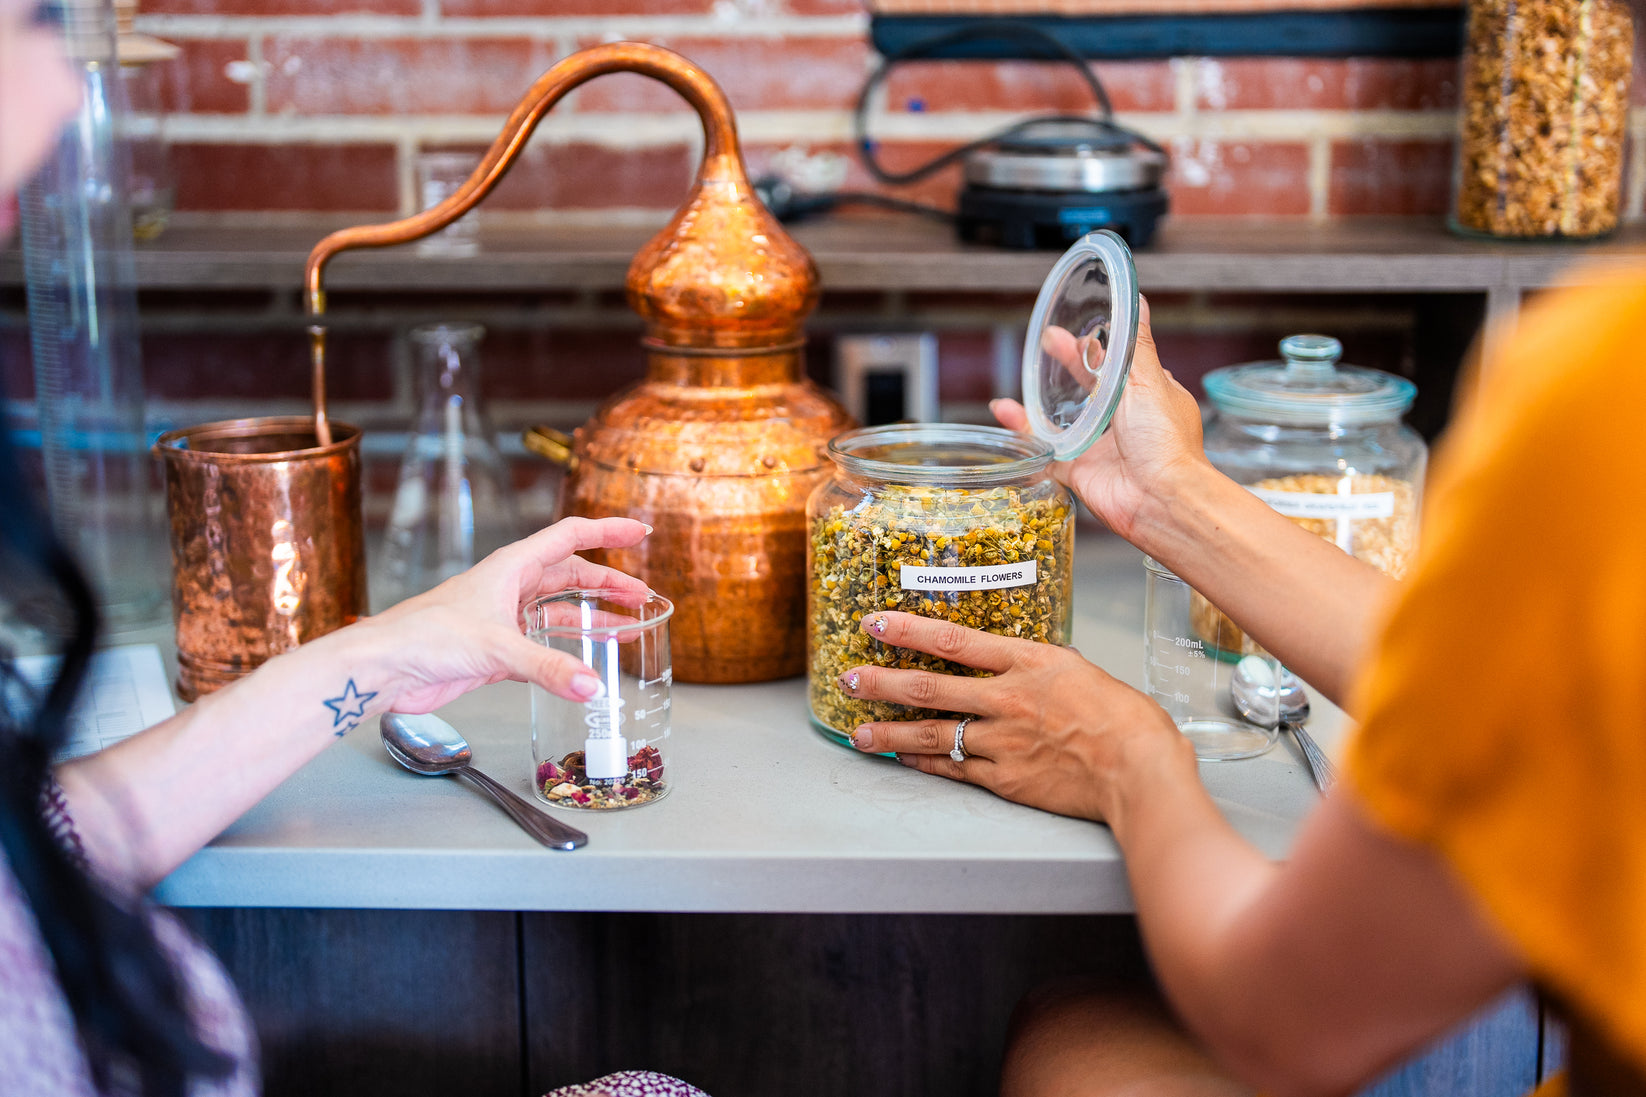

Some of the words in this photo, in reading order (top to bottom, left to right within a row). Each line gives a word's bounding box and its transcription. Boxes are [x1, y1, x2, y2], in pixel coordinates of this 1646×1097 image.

[917, 575, 976, 584] CHAMOMILE
[981, 571, 1023, 583] FLOWERS
[1175, 637, 1204, 649] 200mL
[1175, 664, 1191, 676] 150
[1174, 691, 1190, 704] 100
[634, 709, 646, 720] 50
[630, 739, 648, 750] 100
[632, 767, 648, 779] 150
